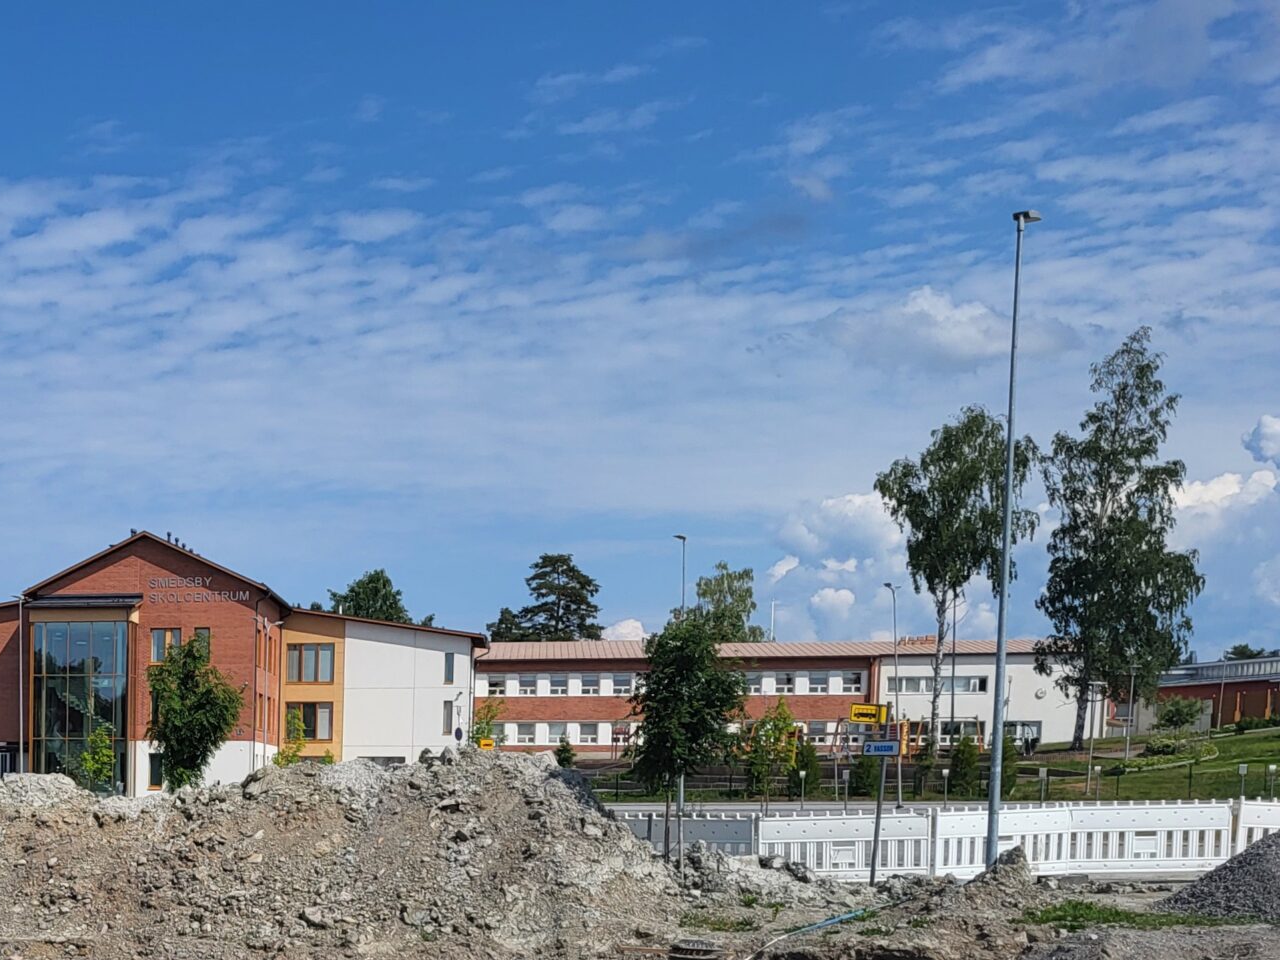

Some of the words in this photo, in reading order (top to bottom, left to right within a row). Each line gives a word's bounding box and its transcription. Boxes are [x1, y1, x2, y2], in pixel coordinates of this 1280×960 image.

[148, 576, 212, 588] SMEDSBY
[148, 590, 250, 604] SKOLCENTRUM
[865, 744, 872, 753] 2
